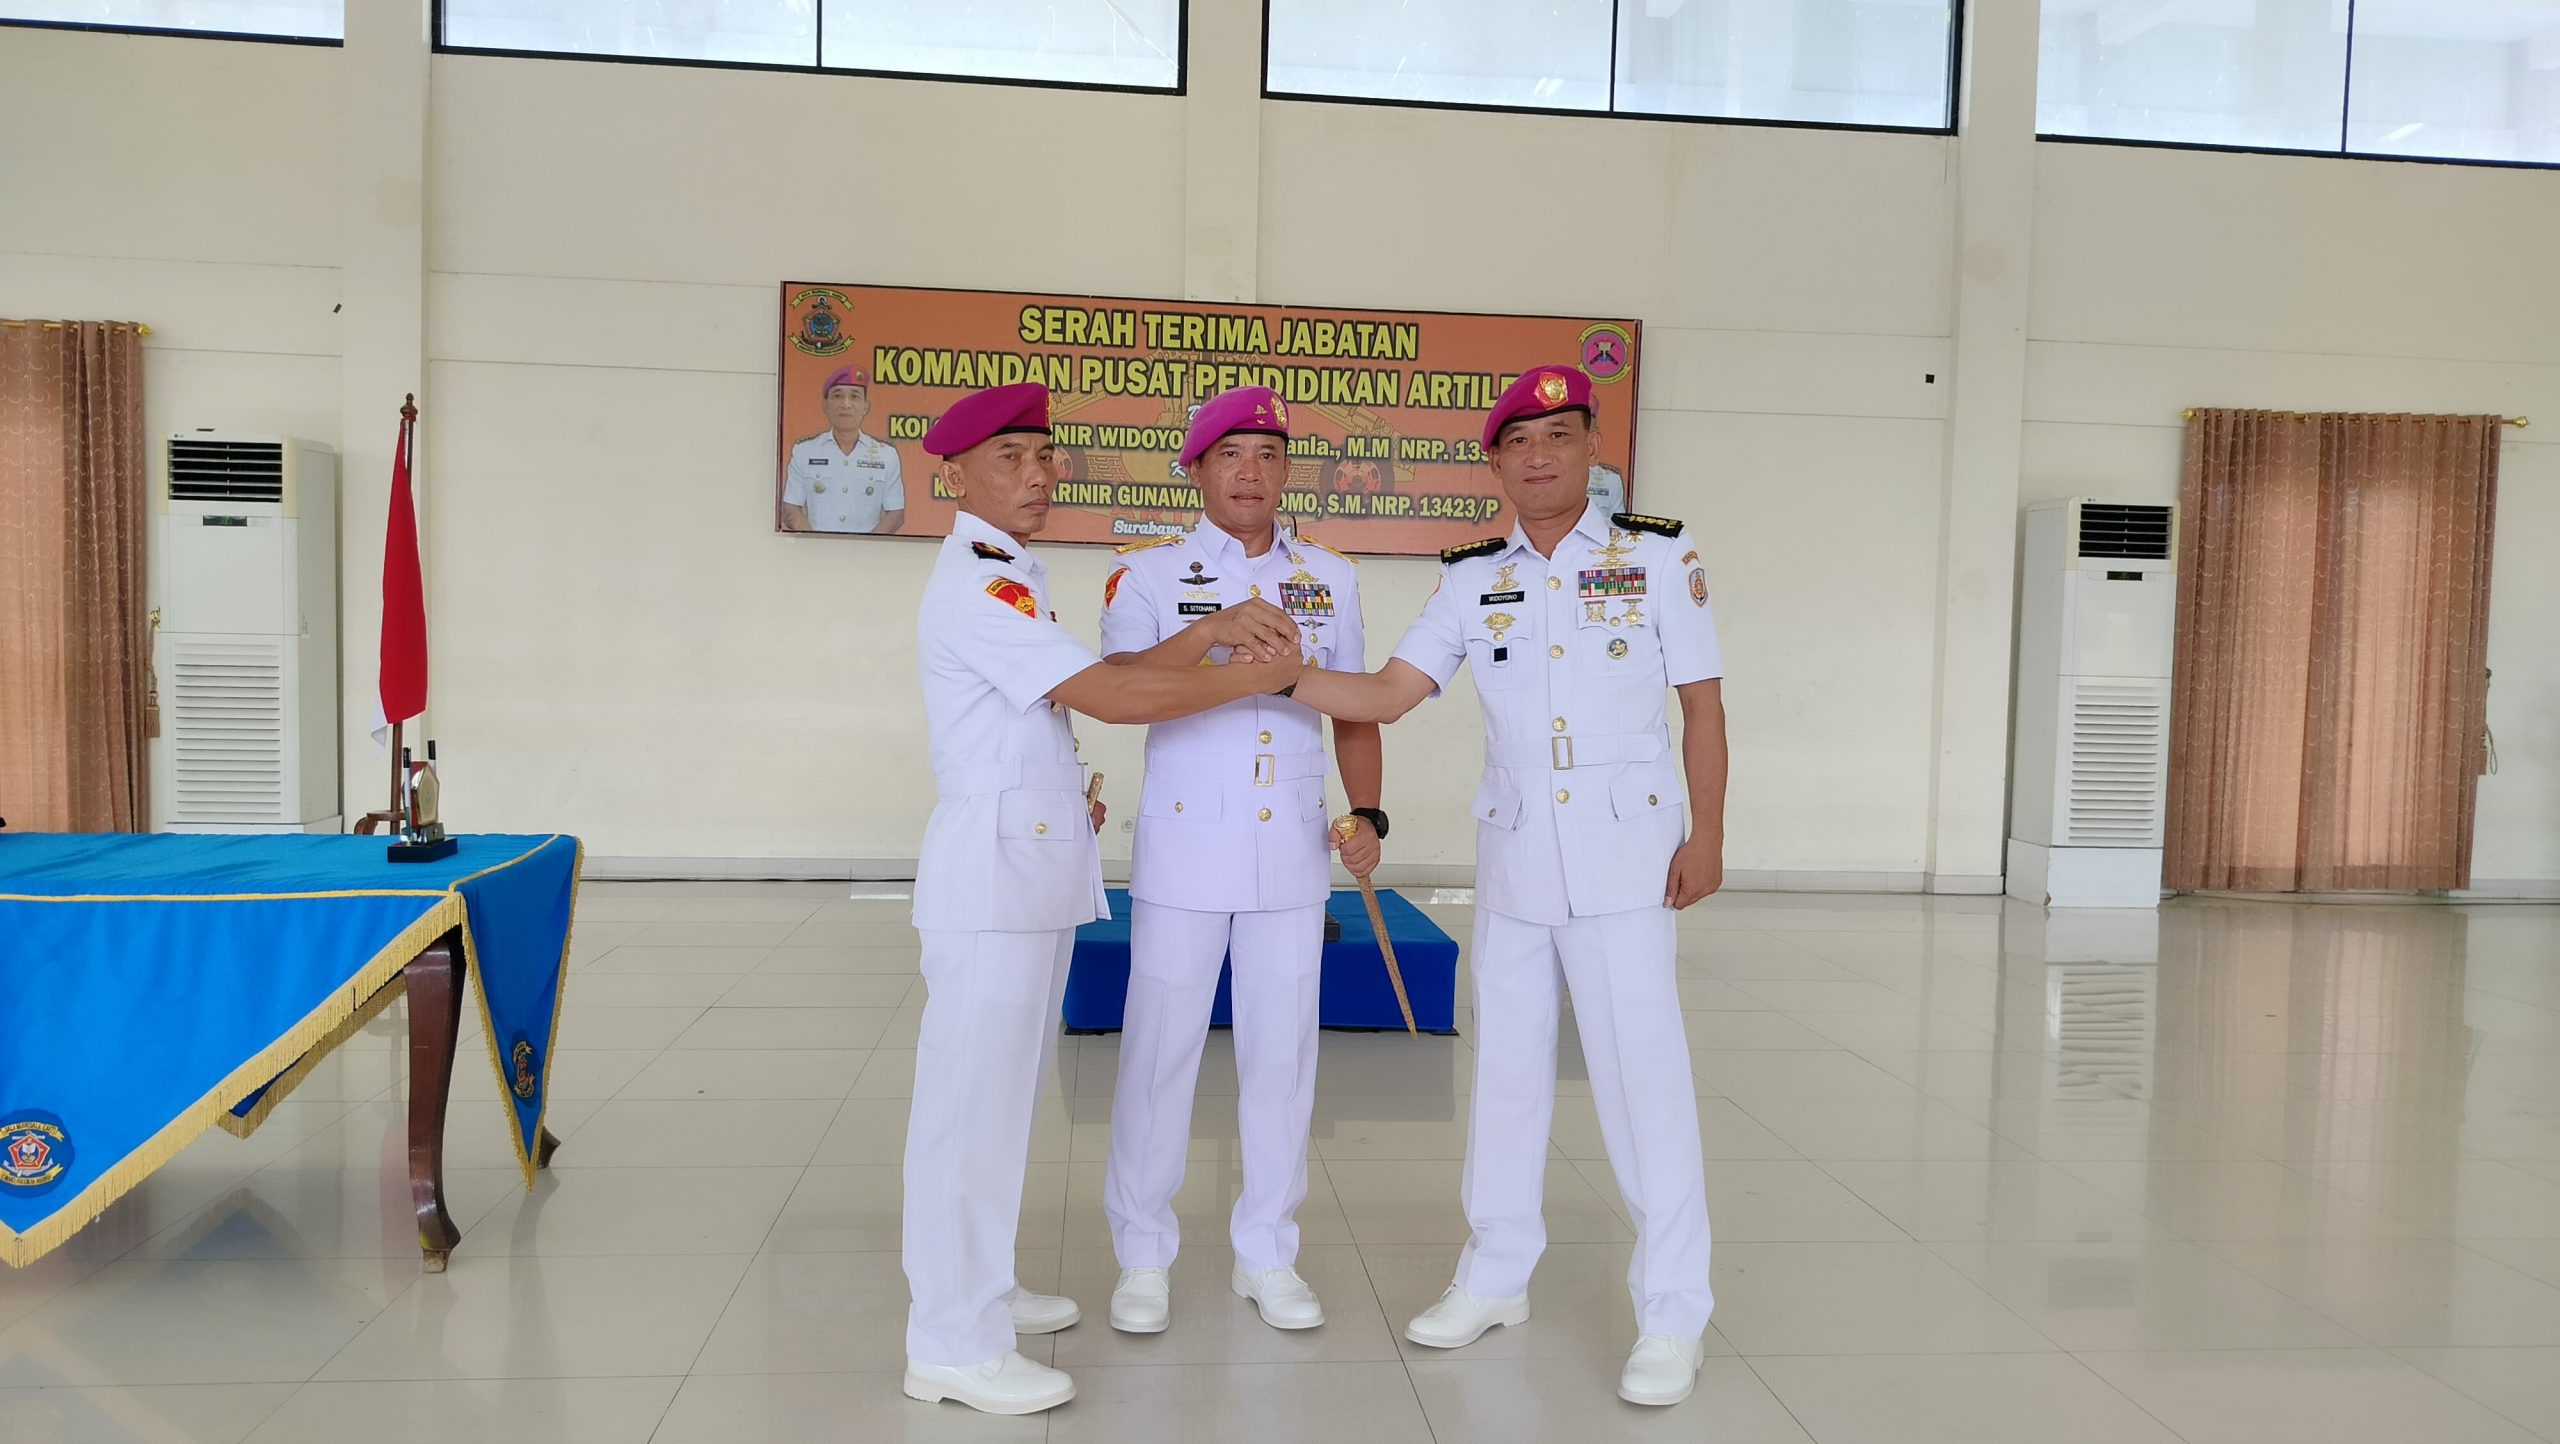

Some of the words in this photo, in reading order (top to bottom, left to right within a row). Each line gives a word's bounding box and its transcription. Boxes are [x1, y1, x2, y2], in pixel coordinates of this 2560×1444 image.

[1021, 307, 1134, 346] SERAH
[1144, 314, 1269, 353] TERIMA
[1277, 320, 1417, 359] JABATAN
[876, 349, 1071, 391] KOMANDAN
[1081, 358, 1186, 396] PUSAT
[1195, 364, 1398, 405] PENDIDIKAN
[1407, 373, 1518, 408] ARTIL
[1098, 426, 1188, 450] WIDOYO
[1287, 436, 1341, 461] anla.,
[1347, 437, 1390, 458] M.M
[1401, 438, 1449, 460] NRP.
[1327, 494, 1366, 514] S.M.
[1371, 495, 1414, 516] NRP.
[1419, 496, 1499, 522] 13423/P
